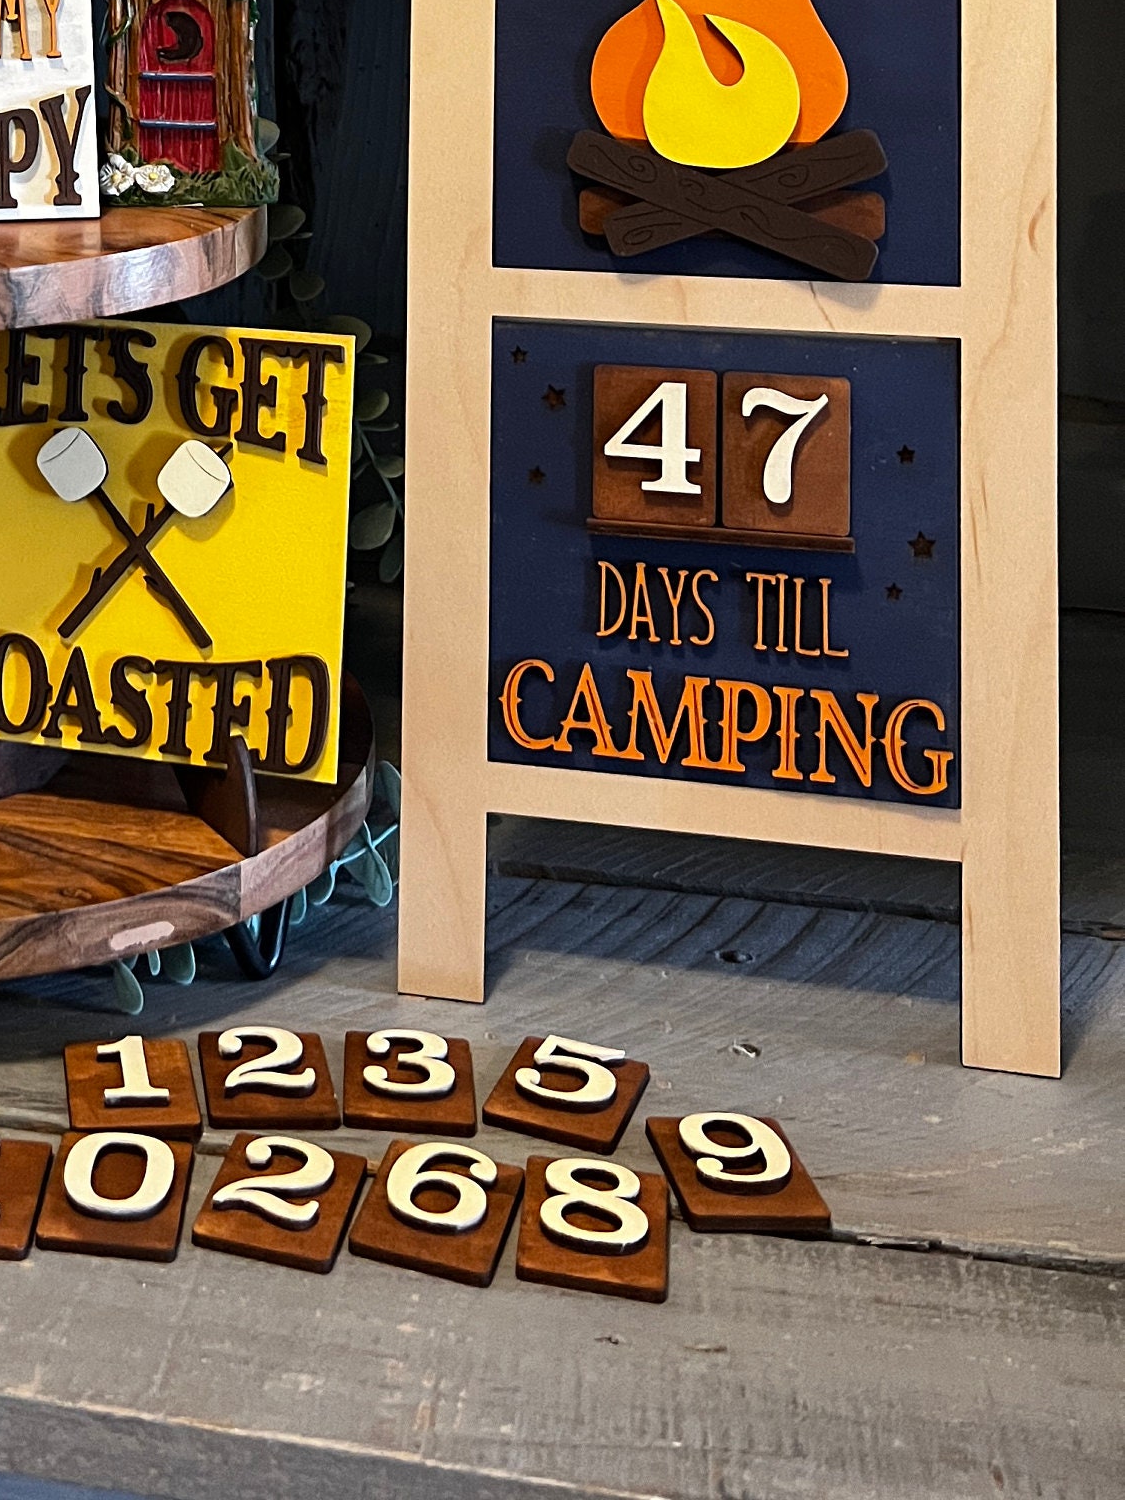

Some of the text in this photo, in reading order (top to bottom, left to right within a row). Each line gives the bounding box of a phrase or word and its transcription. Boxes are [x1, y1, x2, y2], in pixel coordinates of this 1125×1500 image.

[176, 334, 345, 466] GET
[595, 560, 849, 658] DAYS TILL
[497, 658, 954, 795] CAMPING
[97, 1026, 626, 1112] 1 2 3 5
[212, 1135, 334, 1231] 2
[386, 1142, 498, 1234] 6
[539, 1158, 649, 1254] 8
[678, 1112, 792, 1194] 9
